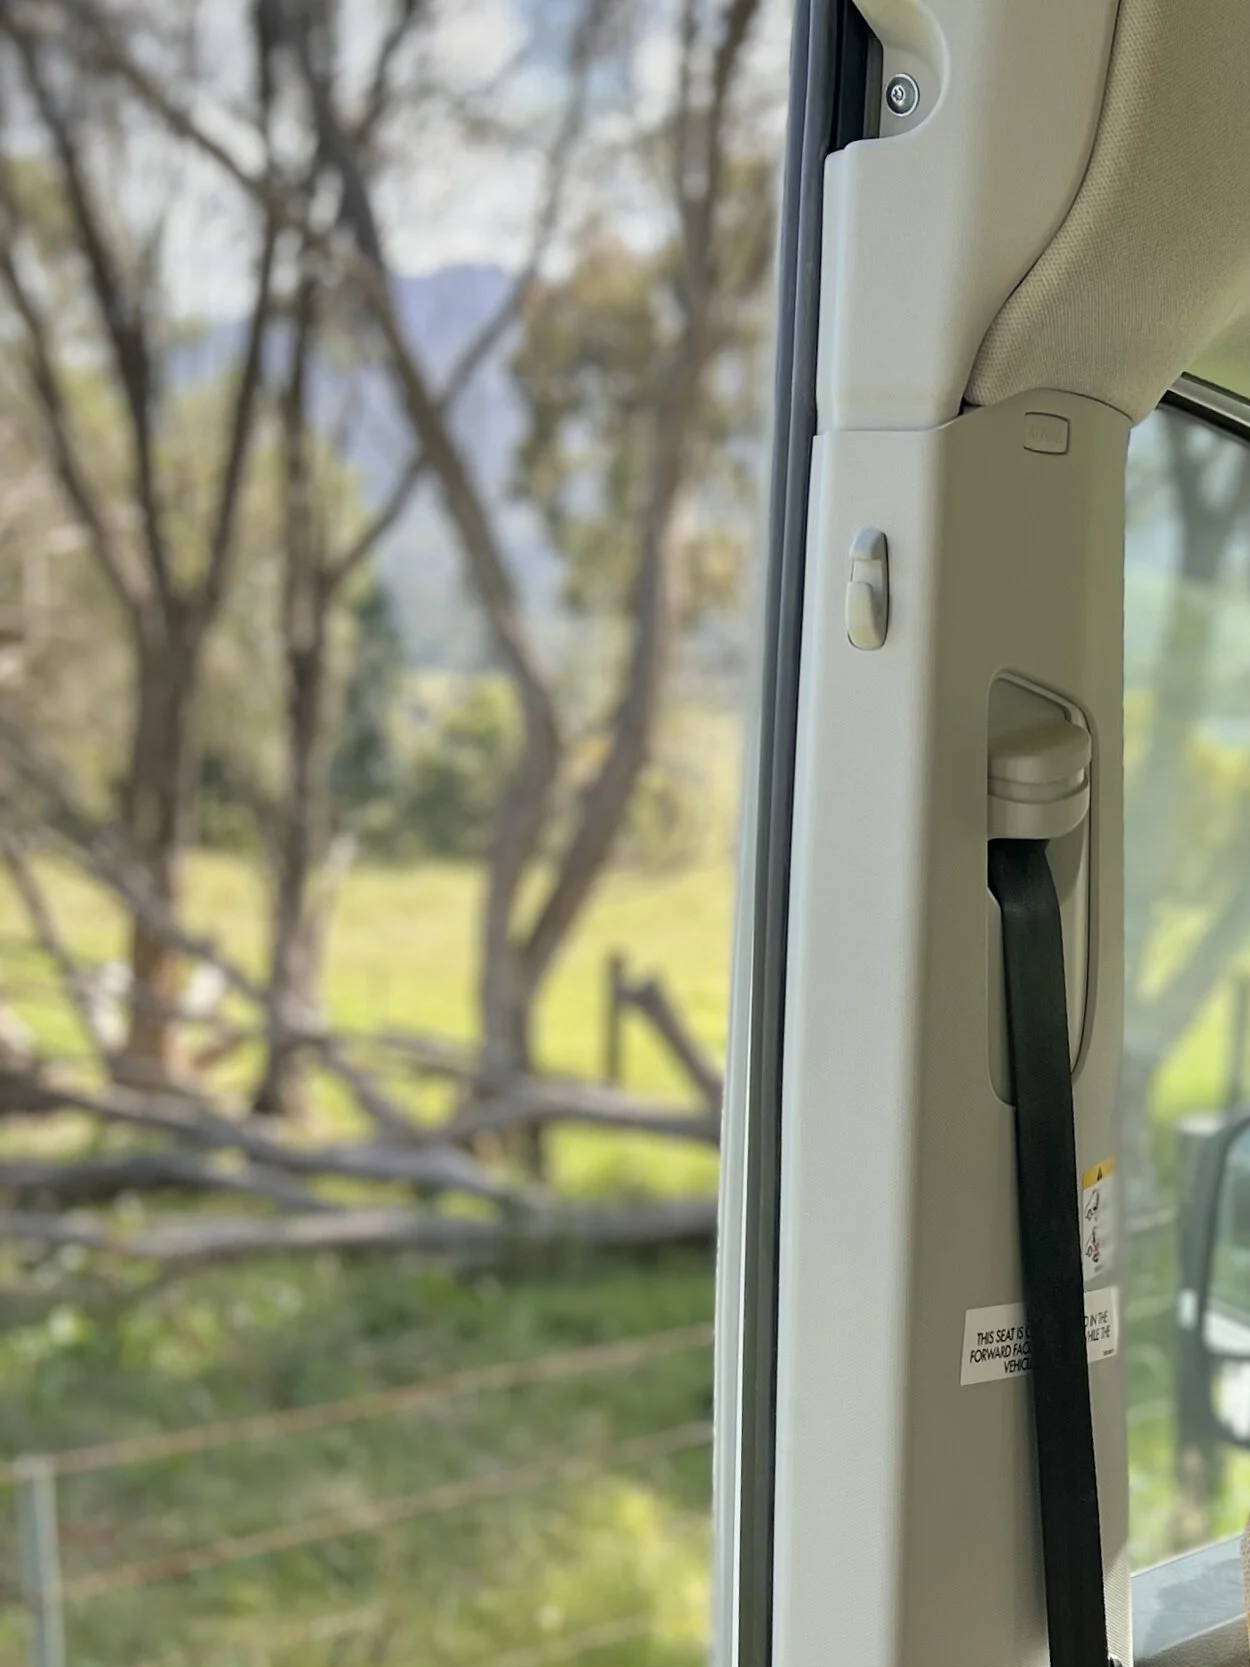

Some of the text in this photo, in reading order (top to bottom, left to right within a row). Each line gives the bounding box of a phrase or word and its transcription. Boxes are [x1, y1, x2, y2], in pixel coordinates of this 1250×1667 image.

[970, 1345, 1011, 1363] FORWARD
[1087, 1329, 1100, 1342] HILE
[1101, 1325, 1111, 1340] THE
[977, 1330, 994, 1346] THIS
[996, 1327, 1015, 1343] SEAT
[1017, 1326, 1024, 1341] IS
[1090, 1314, 1097, 1327] IN
[1098, 1310, 1109, 1325] THE
[1004, 1359, 1032, 1374] VEHICL
